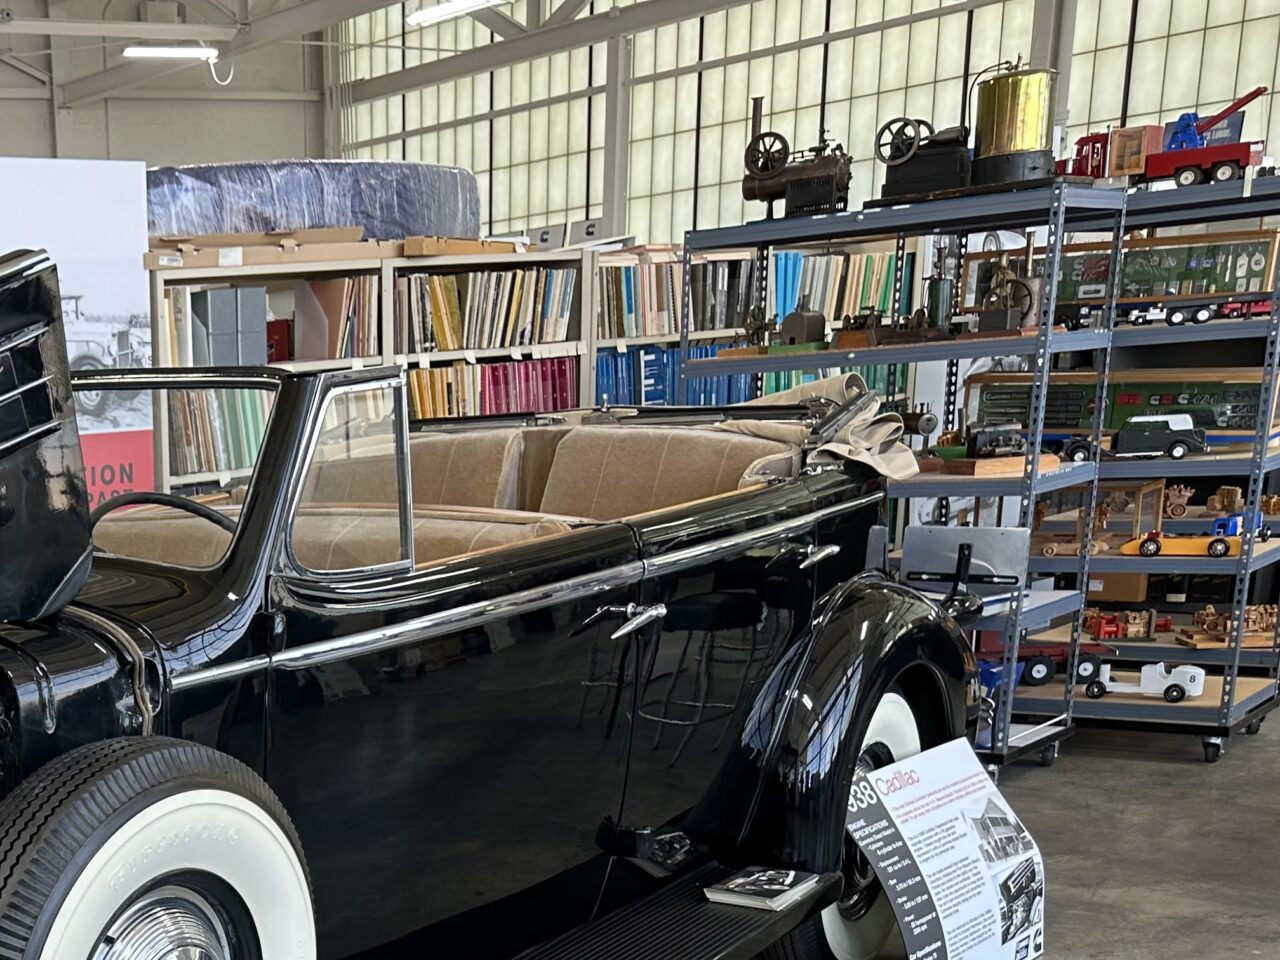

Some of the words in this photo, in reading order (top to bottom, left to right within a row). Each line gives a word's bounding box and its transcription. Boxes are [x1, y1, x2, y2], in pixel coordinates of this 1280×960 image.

[91, 462, 133, 486] ION
[1189, 674, 1197, 683] 8
[847, 781, 878, 813] 938
[875, 769, 920, 797] Cadillac
